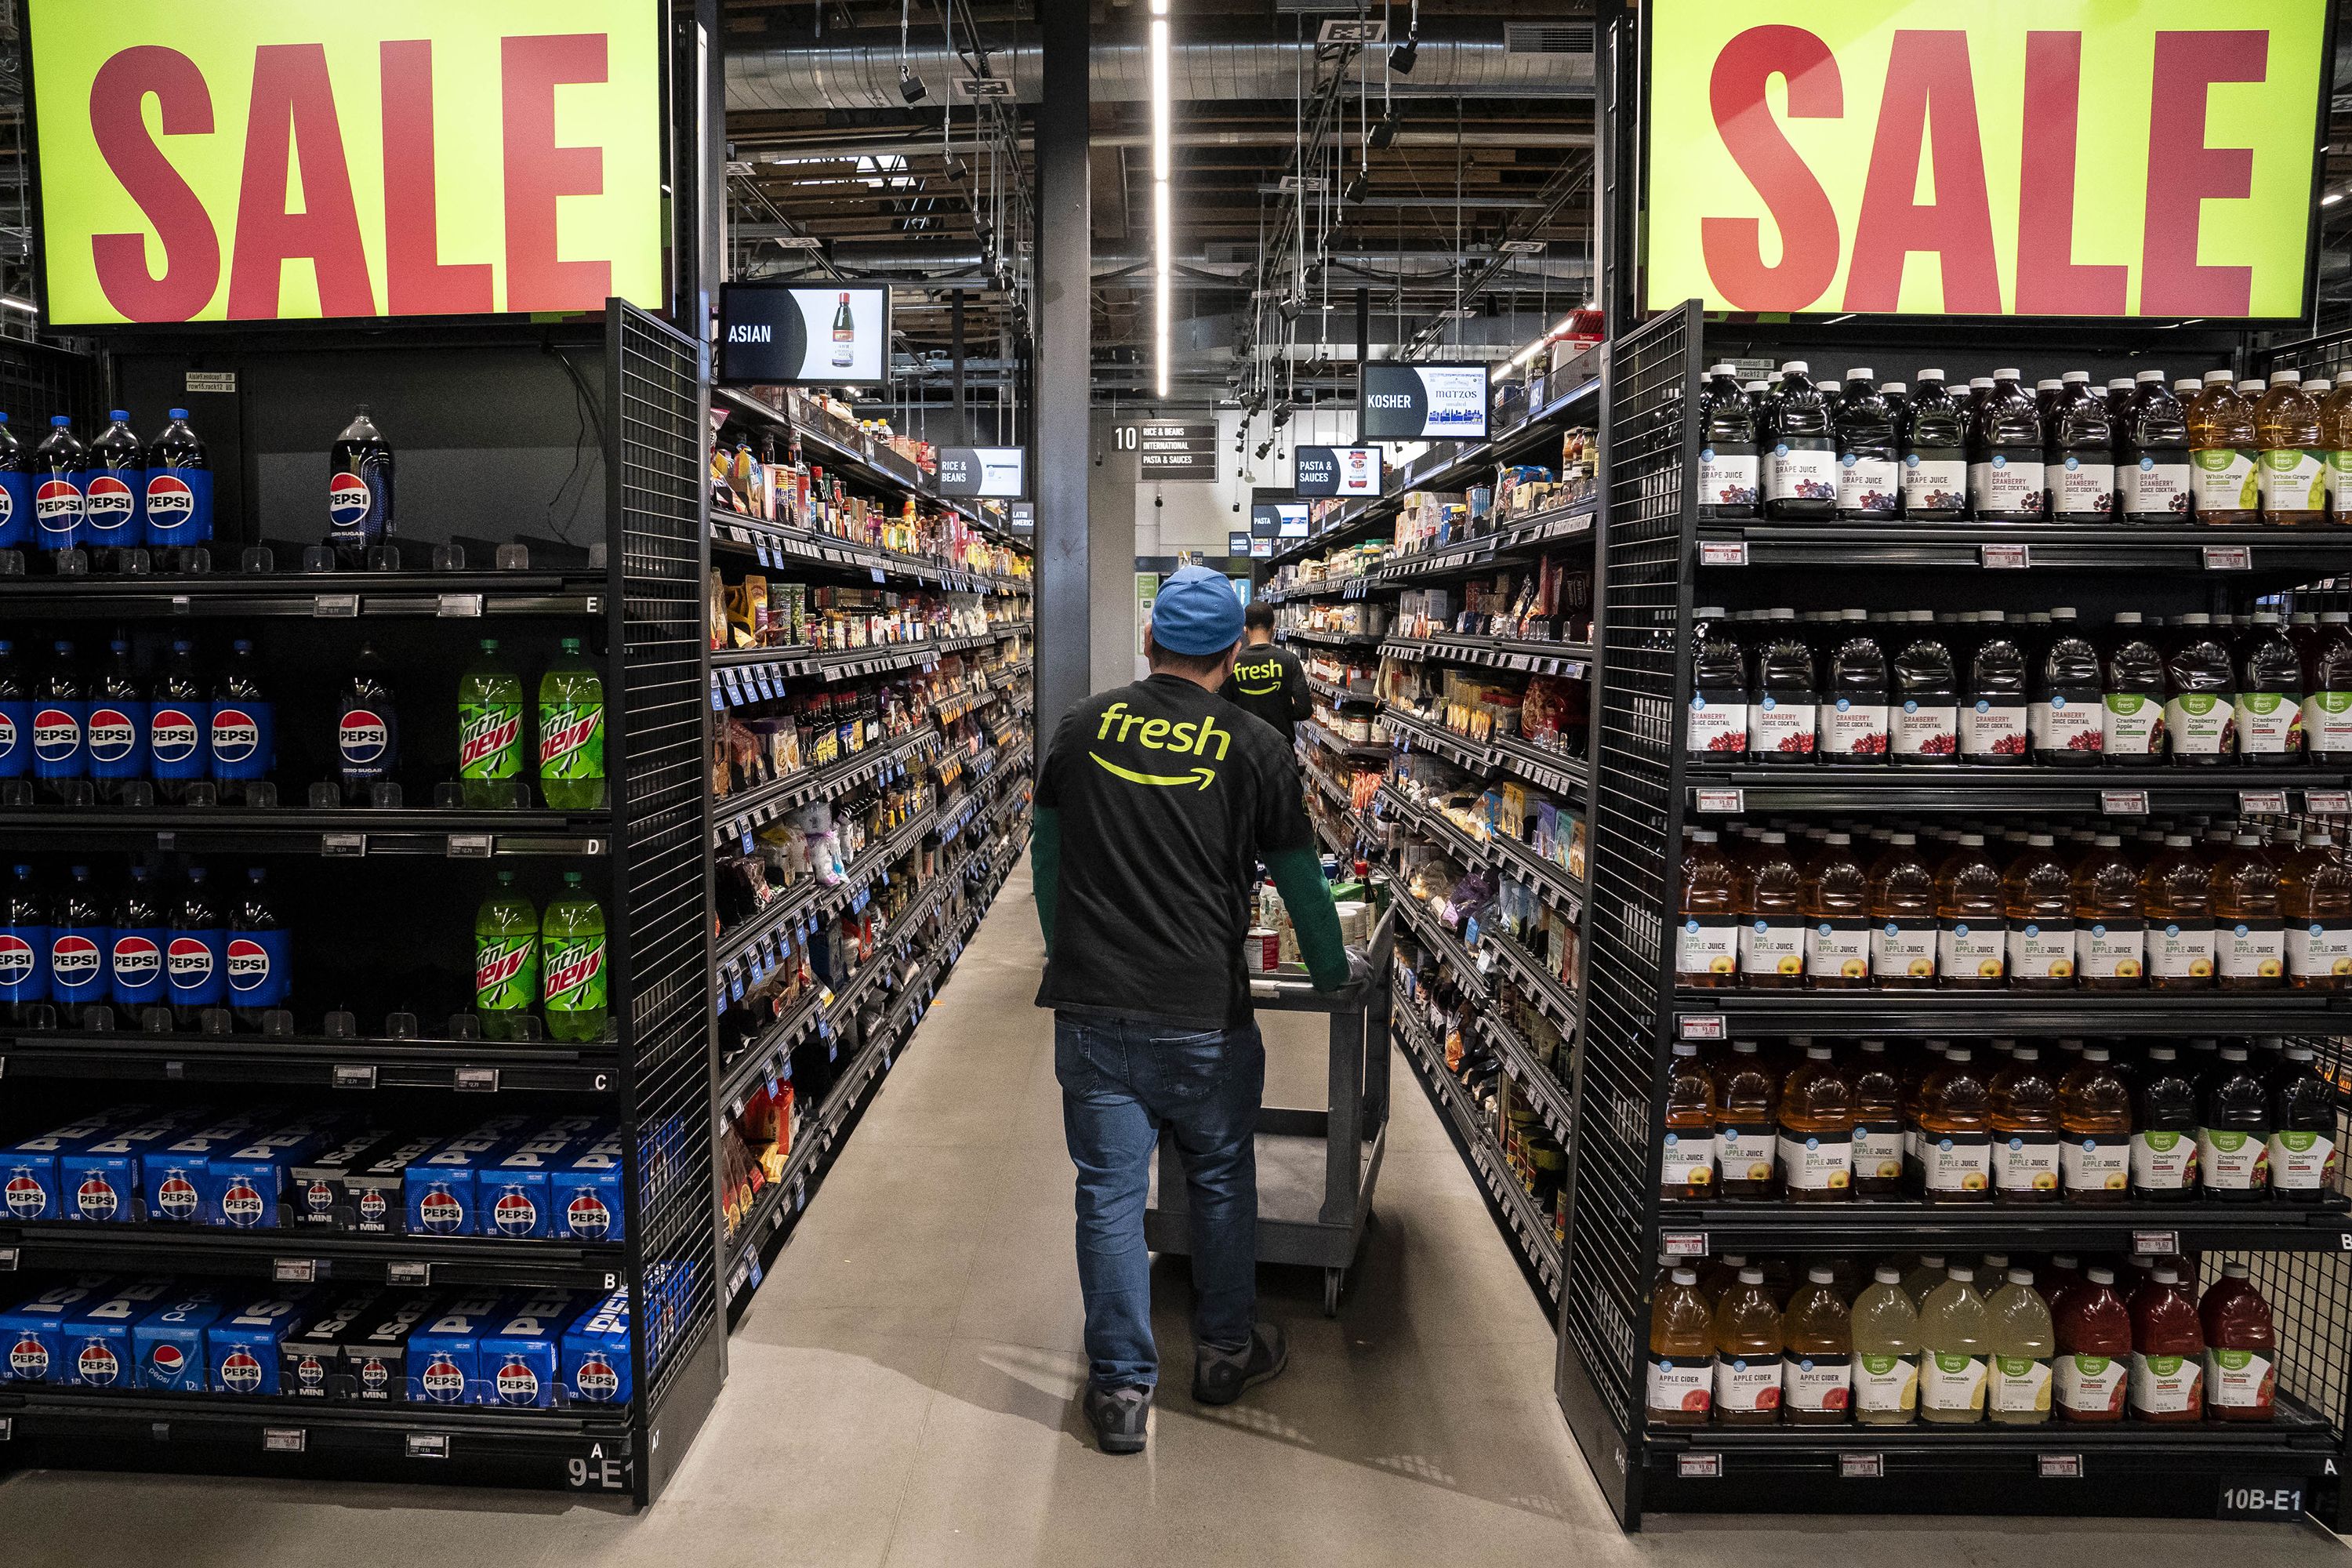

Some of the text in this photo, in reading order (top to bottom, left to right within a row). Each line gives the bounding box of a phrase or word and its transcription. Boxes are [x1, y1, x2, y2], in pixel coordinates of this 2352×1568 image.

[1702, 24, 2269, 316] SALE
[90, 34, 612, 323] SALE
[728, 325, 771, 342] ASIAN
[1368, 395, 1411, 408] KOSHER
[1116, 427, 1136, 449] 10
[942, 462, 966, 470] RICE &
[1300, 462, 1332, 470] PASTA &
[2206, 457, 2225, 466] fresh
[942, 473, 966, 481] BEANS
[1300, 473, 1328, 482] SAUCES
[39, 501, 82, 514] PEPSI
[89, 497, 131, 508] PEPSI
[148, 497, 190, 508] PEPSI
[2005, 555, 2019, 564] $1.67
[586, 597, 597, 612] E
[1233, 659, 1282, 682] fresh
[35, 730, 77, 740] PEPSI
[90, 730, 131, 741] PEPSI
[154, 731, 194, 741] PEPSI
[213, 731, 254, 741] PEPSI
[341, 731, 383, 742] PEPSI
[1098, 702, 1231, 760] fresh
[588, 840, 598, 854] D
[0, 955, 30, 965] EPSI
[54, 955, 97, 966] PEPSI
[115, 956, 157, 966] PEPSI
[169, 957, 210, 968] PEPSI
[228, 959, 266, 971] PEPSI
[595, 1075, 606, 1091] C
[9, 1193, 43, 1202] PEPSI
[81, 1196, 114, 1206] PEPSI
[162, 1193, 195, 1203] PEPSI
[309, 1193, 331, 1202] PEPSI
[226, 1200, 260, 1210] PEPSI
[362, 1202, 384, 1210] PEPSI
[423, 1208, 459, 1219] PEPSI
[498, 1210, 533, 1221] PEPSI
[571, 1213, 607, 1224] PEPSI
[2341, 1234, 2352, 1250] B
[604, 1274, 615, 1288] B
[13, 1355, 46, 1363] PEPSI
[82, 1361, 116, 1370] PEPSI
[148, 1367, 169, 1385] pepsi
[225, 1368, 260, 1377] PEPSI
[299, 1369, 322, 1377] PEPSI
[363, 1370, 387, 1379] PEPSI
[426, 1376, 462, 1388] PEPSI
[499, 1380, 535, 1391] PEPSI
[579, 1374, 615, 1387] PEPSI
[299, 1388, 324, 1396] MINI
[591, 1443, 603, 1458] A
[2325, 1459, 2338, 1475] A
[2224, 1488, 2300, 1512] 10B-E1
